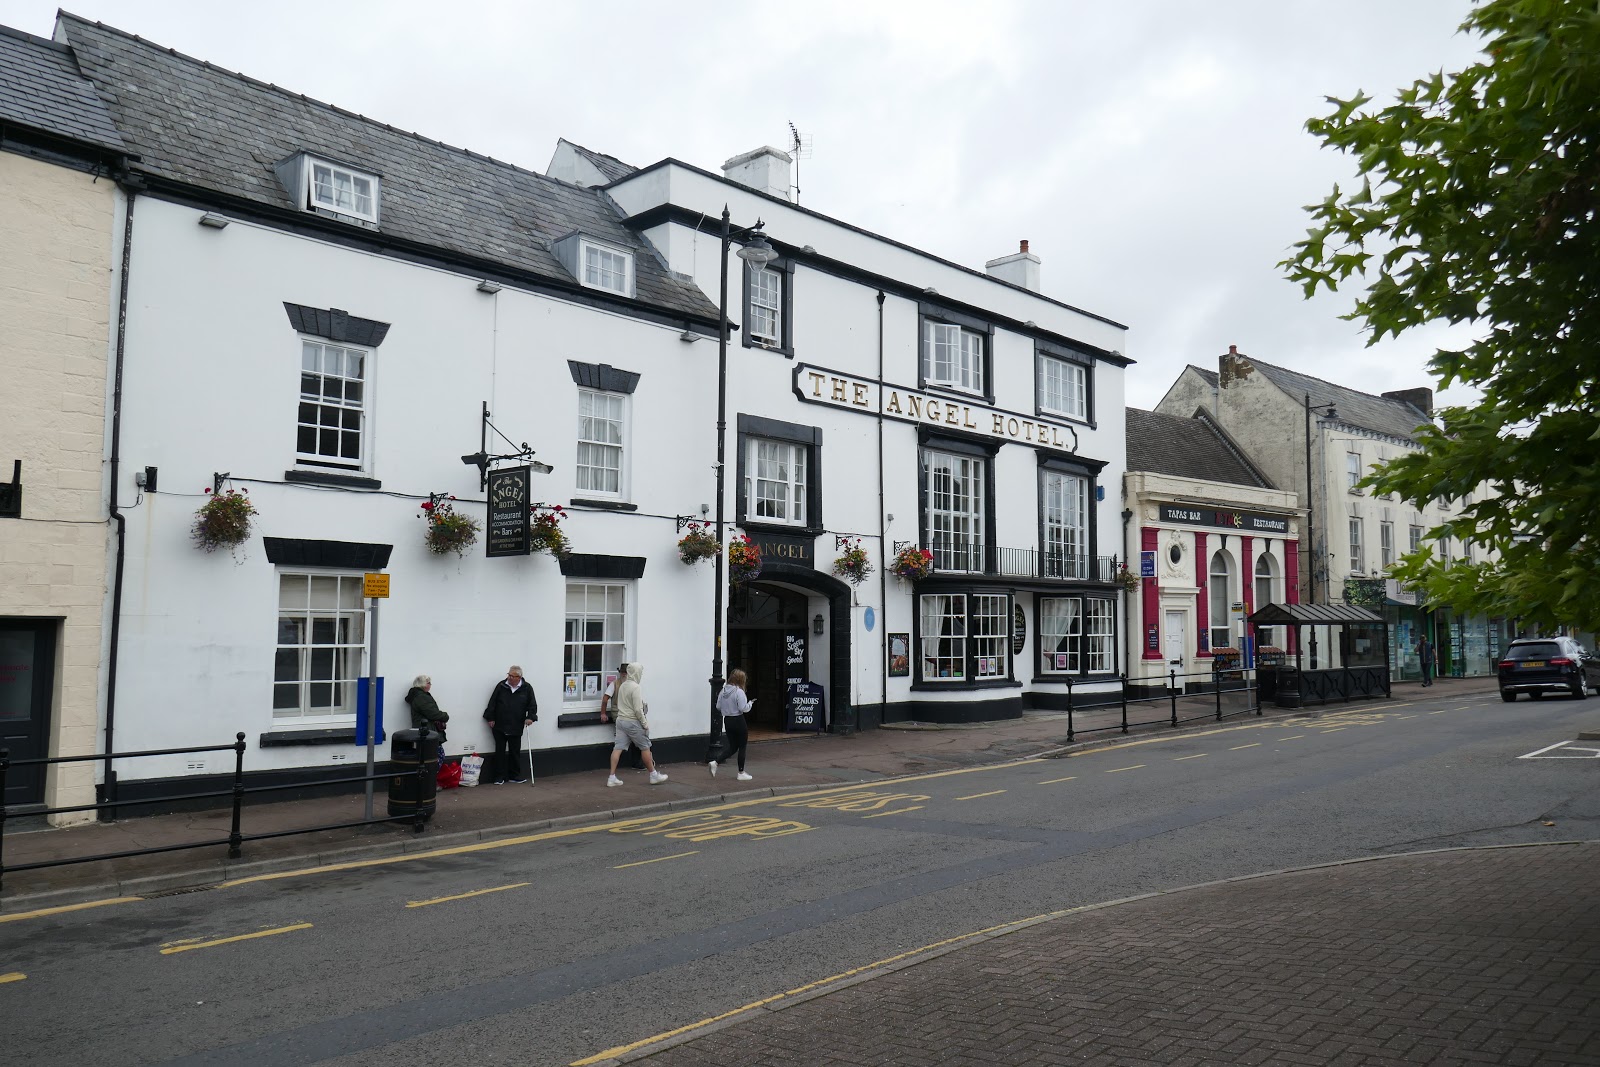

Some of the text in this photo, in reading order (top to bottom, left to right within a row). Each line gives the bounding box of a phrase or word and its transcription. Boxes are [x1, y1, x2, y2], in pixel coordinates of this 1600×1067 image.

[808, 371, 869, 407] THE
[886, 391, 977, 429] ANGEL
[492, 486, 524, 506] ANGEL
[498, 500, 517, 508] HOTEL
[493, 511, 521, 520] Restaurant
[1167, 509, 1201, 521] TAPAS BAR
[1253, 518, 1285, 530] RESTAURANT
[501, 528, 513, 536] Bars
[756, 541, 809, 559] ANGEL
[792, 696, 820, 705] SENIORS
[608, 813, 811, 843] STOP
